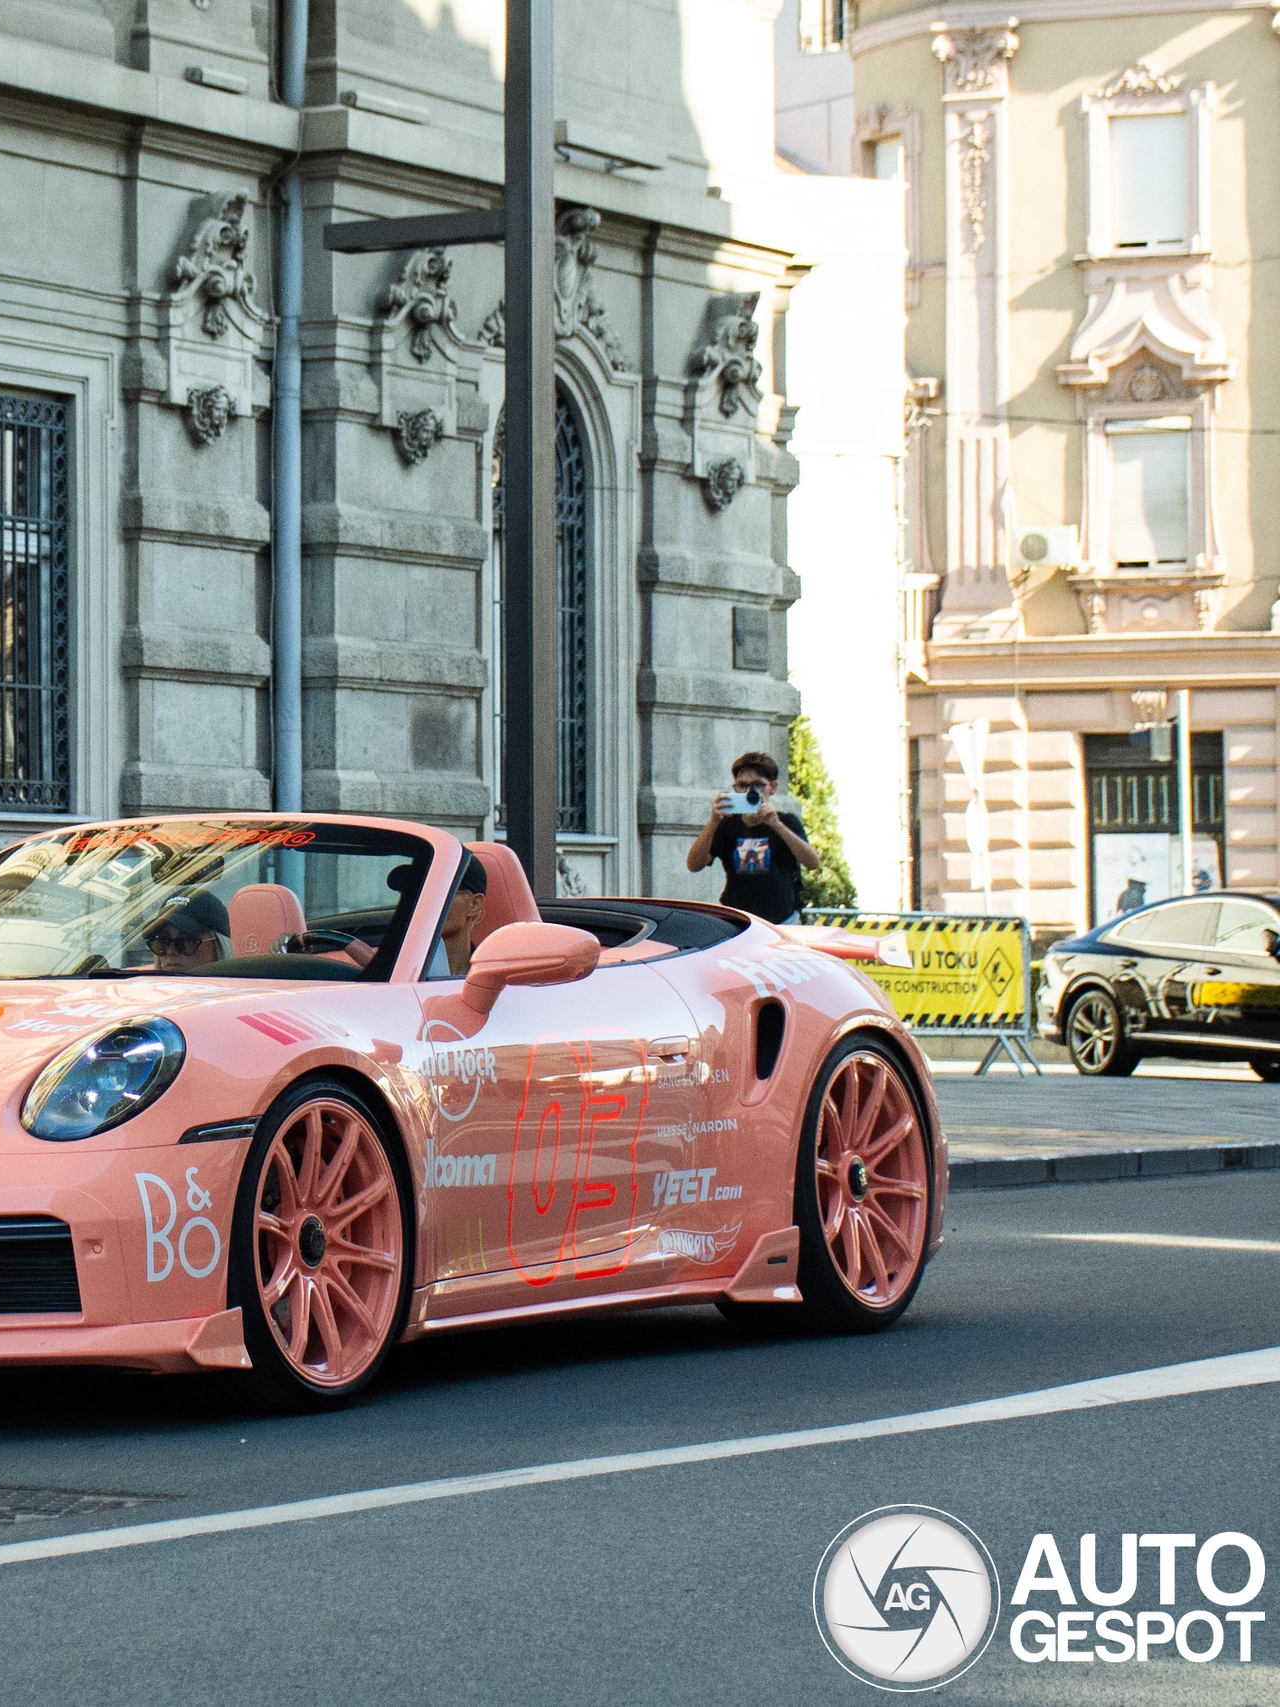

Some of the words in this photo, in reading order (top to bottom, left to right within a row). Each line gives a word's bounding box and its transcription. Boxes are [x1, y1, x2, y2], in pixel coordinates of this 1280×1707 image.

[921, 950, 931, 969] U
[935, 951, 978, 969] TOKU
[894, 980, 978, 994] CONSTRUCTION
[453, 1044, 498, 1084] Rock
[657, 1123, 687, 1138] ULYSSE
[693, 1118, 738, 1133] NARDIN
[652, 1167, 743, 1207] YEET.com
